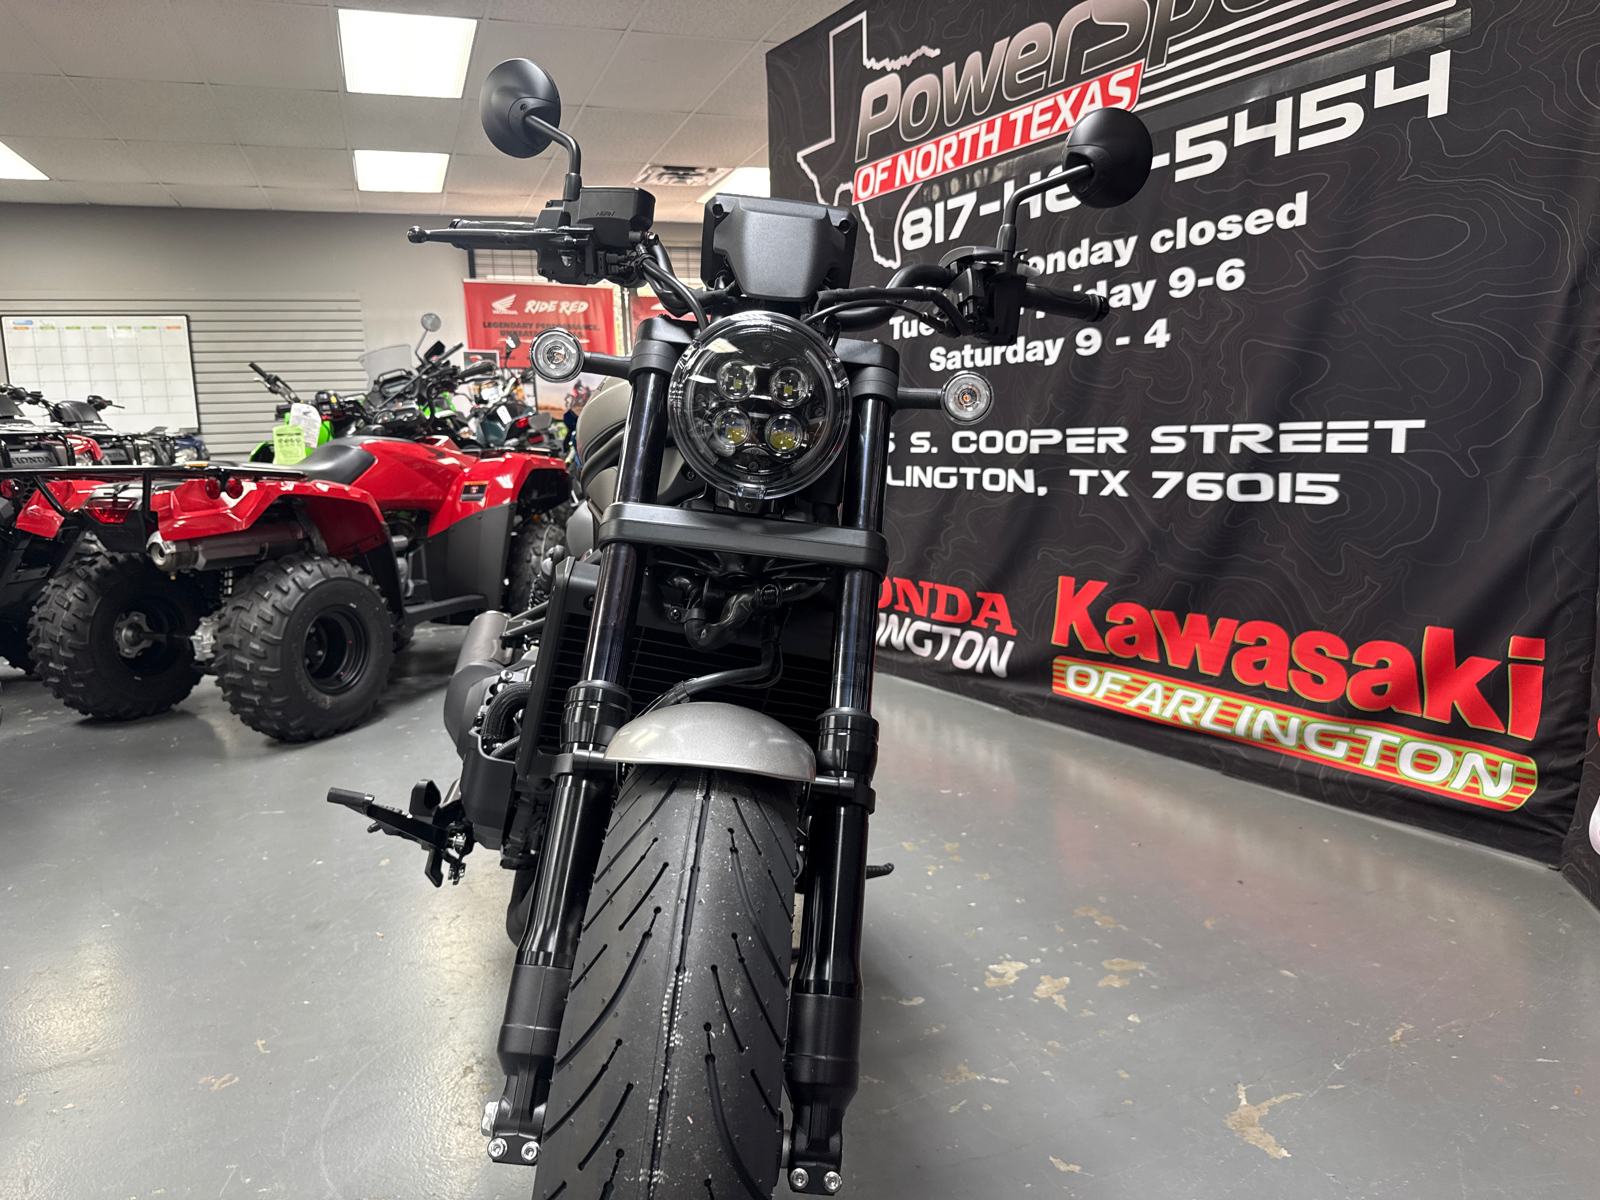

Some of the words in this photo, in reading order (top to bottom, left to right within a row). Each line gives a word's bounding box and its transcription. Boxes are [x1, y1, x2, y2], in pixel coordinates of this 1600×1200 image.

[856, 158, 893, 200] OF
[895, 117, 1003, 188] NORTH
[1008, 66, 1136, 148] TEXAS
[901, 49, 1451, 251] 817-46-5454
[1026, 234, 1139, 275] onday
[1149, 190, 1308, 254] closed
[1168, 258, 1246, 299] 9-6
[482, 321, 534, 329] LEGENDARY
[524, 299, 559, 315] RIDE
[559, 300, 589, 316] RED
[929, 335, 1066, 372] Saturday
[1075, 327, 1103, 357] 9
[1115, 335, 1131, 346] -
[1143, 317, 1172, 349] 4
[11, 455, 54, 465] HONDA
[909, 430, 939, 454] S.
[951, 426, 1129, 455] COOPER
[1150, 418, 1427, 455] STREET
[886, 465, 1048, 498] LINGTON,
[1069, 468, 1131, 498] TX
[1150, 470, 1342, 505] 76015
[1050, 574, 1547, 742] Kawasaki
[1065, 664, 1131, 702] OF
[1125, 688, 1516, 801] ARLINGTON
